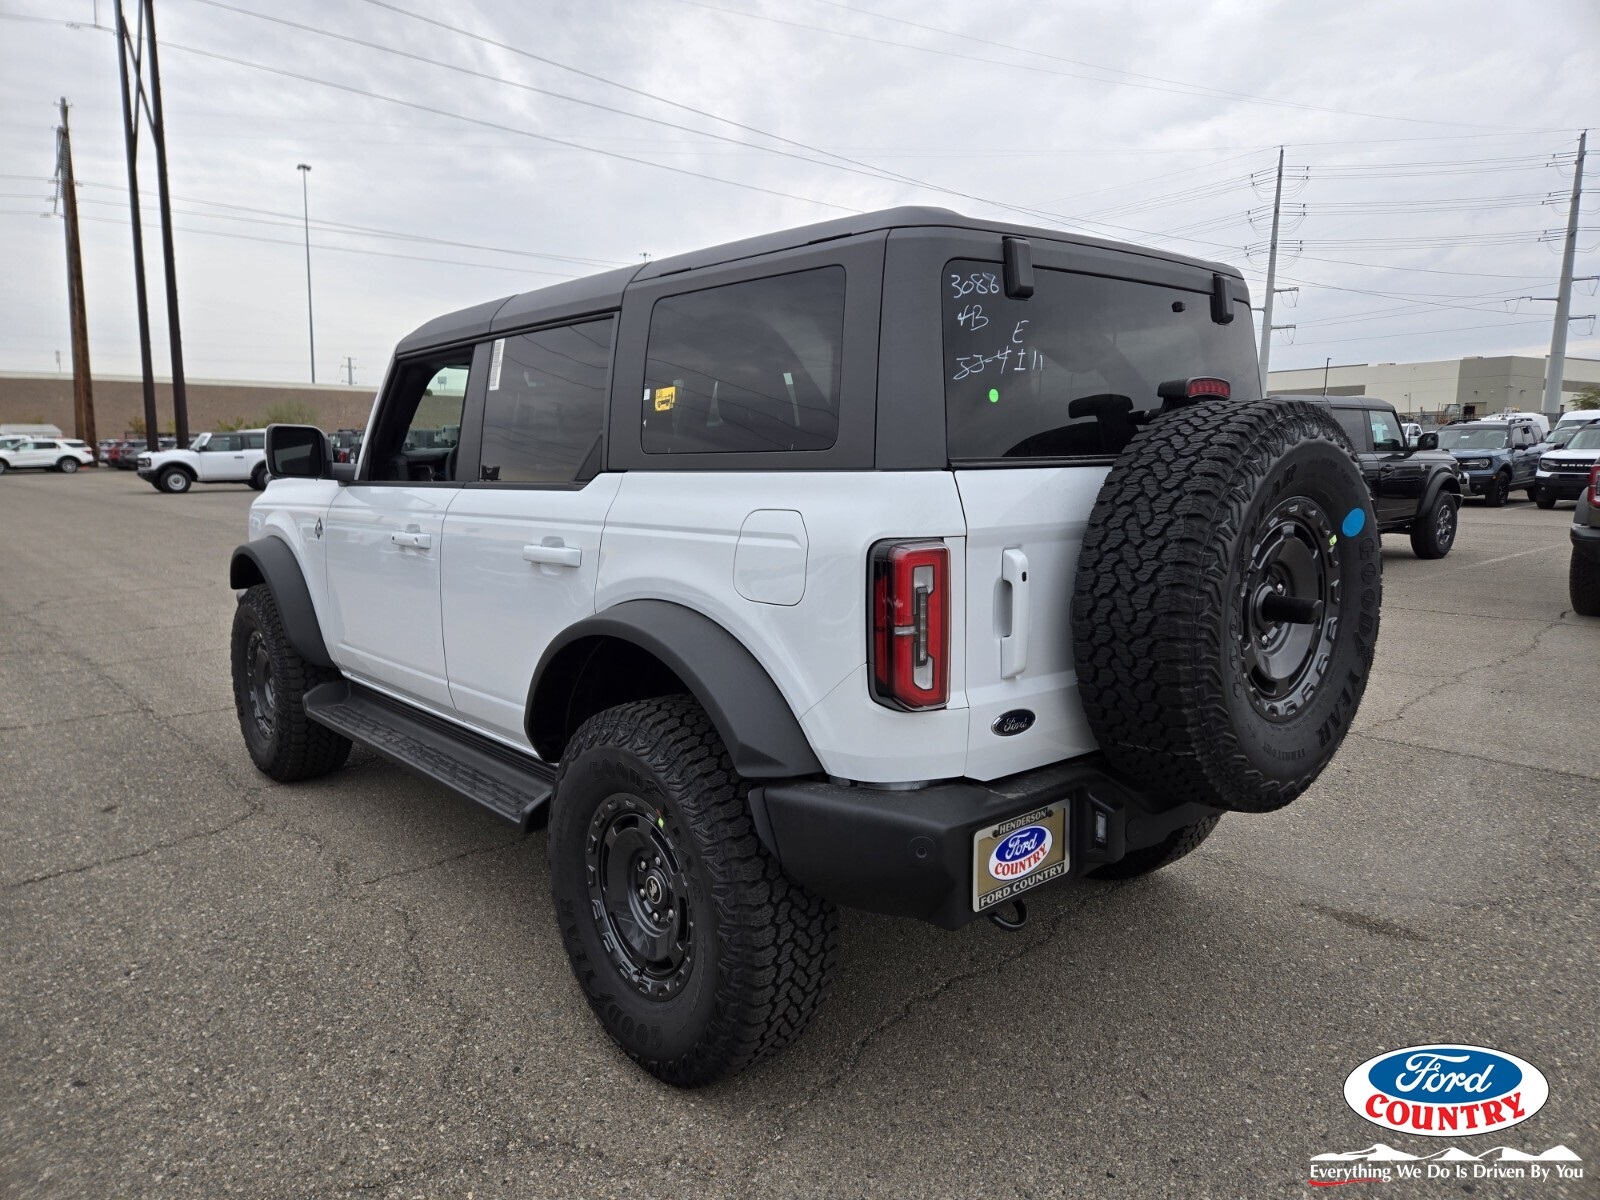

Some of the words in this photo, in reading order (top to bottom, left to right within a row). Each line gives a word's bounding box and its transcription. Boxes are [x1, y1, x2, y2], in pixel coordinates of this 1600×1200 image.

[1315, 537, 1377, 748] GOODYEAR
[1000, 809, 1047, 834] HENDERSON
[994, 844, 1047, 876] COUNTRY
[1005, 832, 1038, 860] Ford
[980, 887, 1011, 908] FORD
[1012, 864, 1064, 891] COUNTRY
